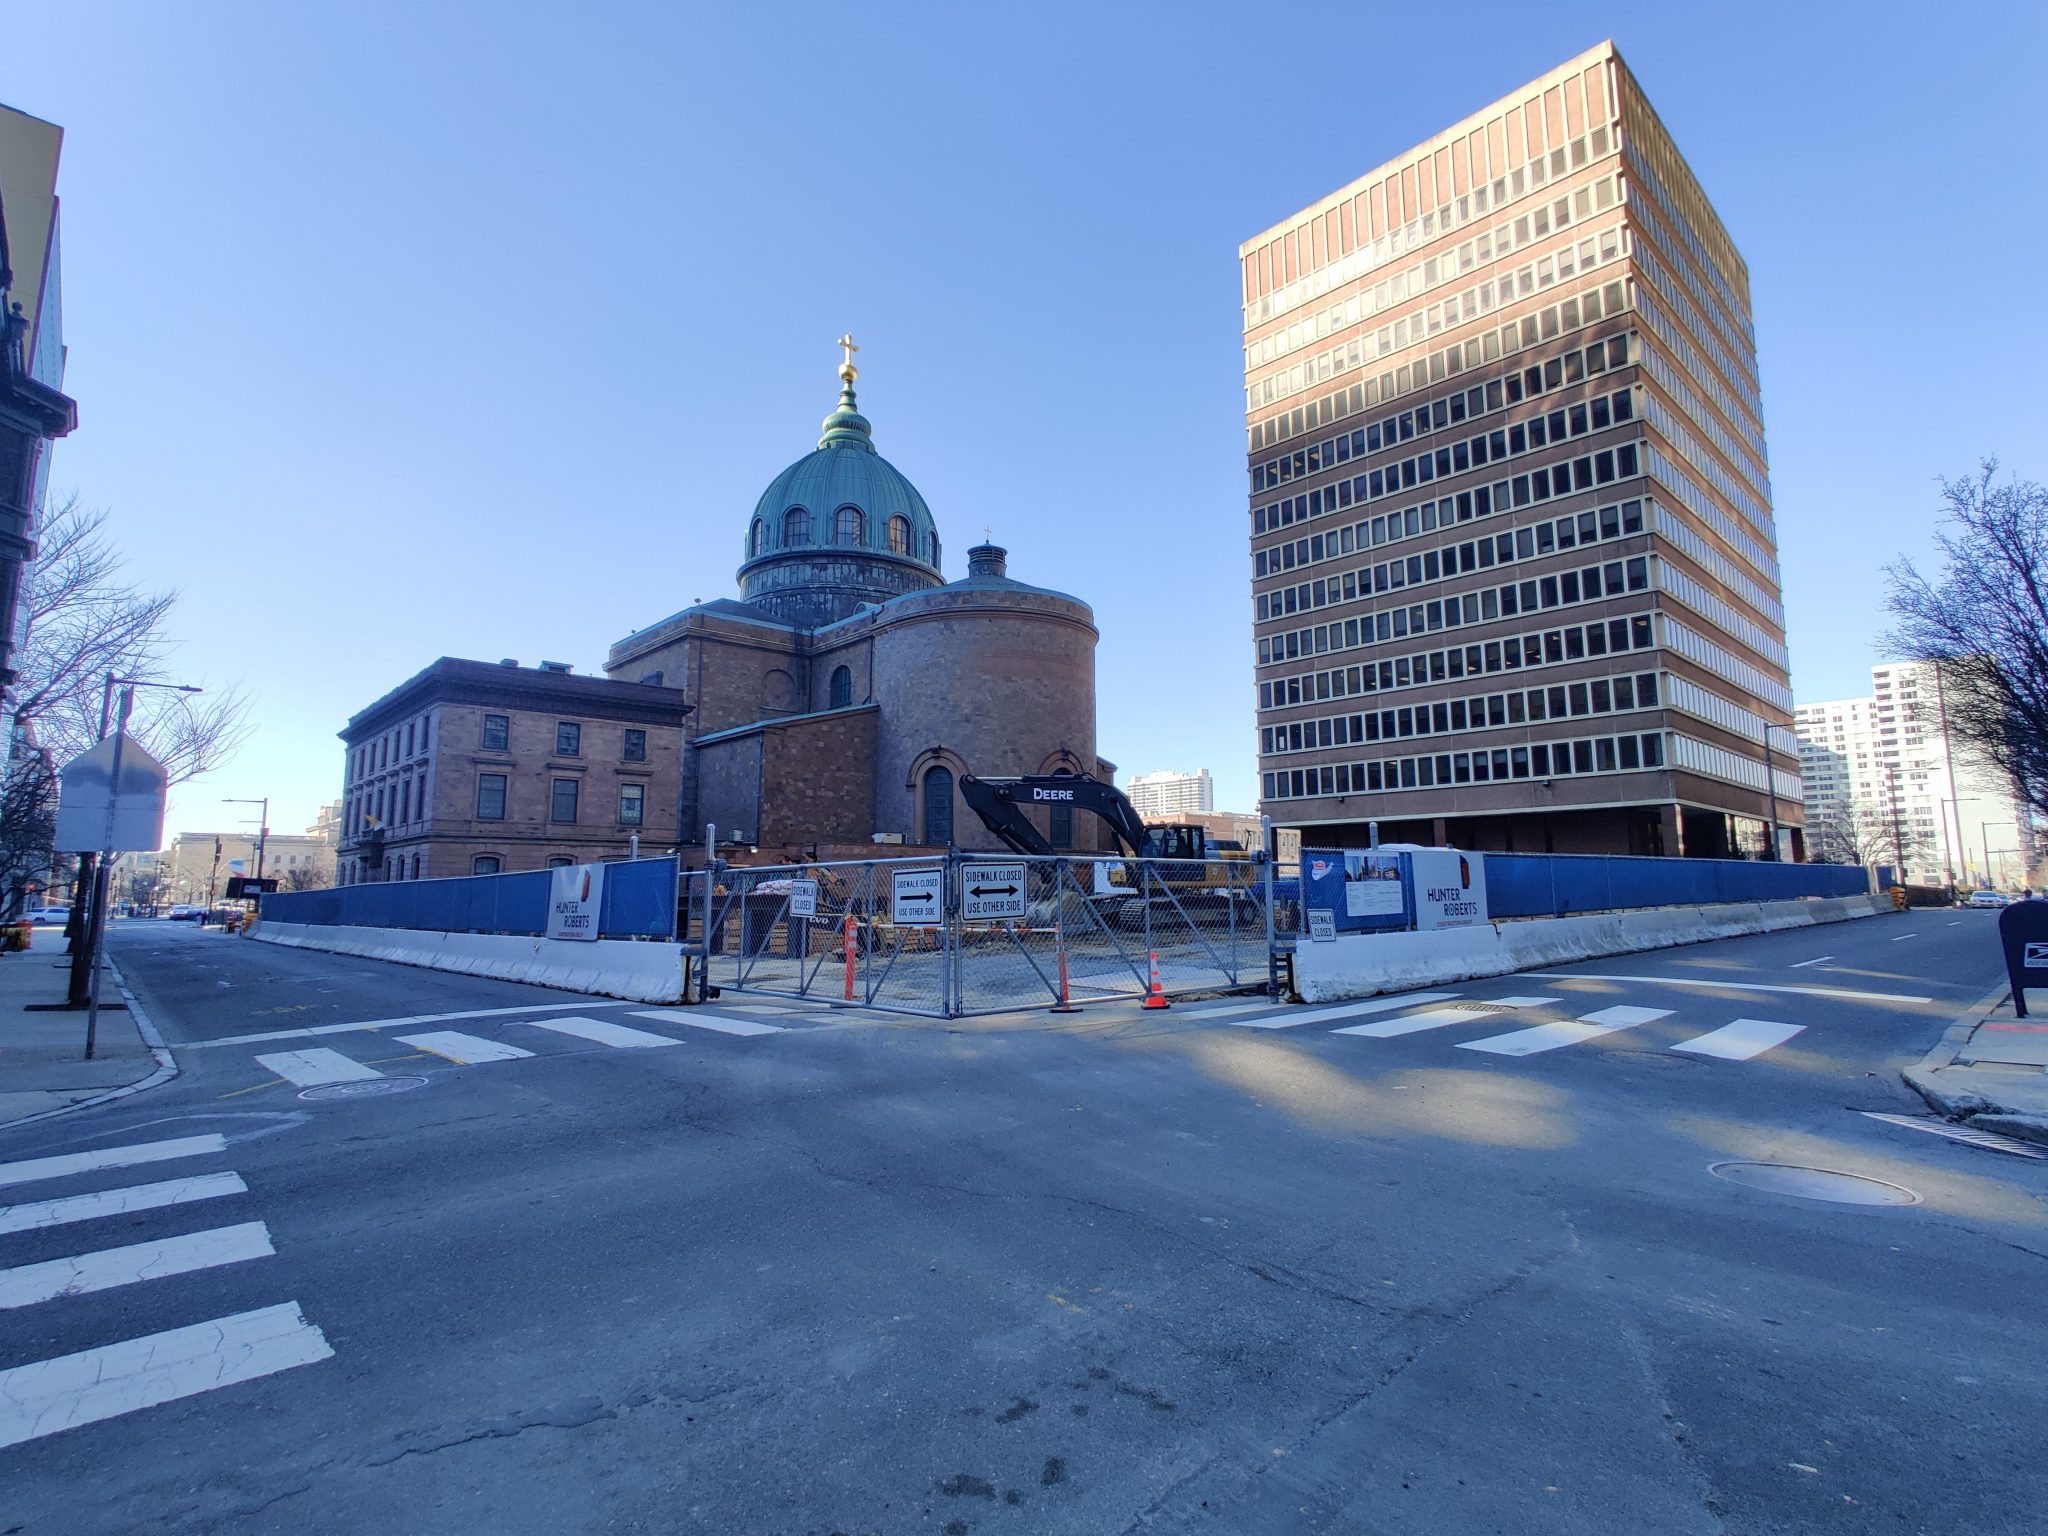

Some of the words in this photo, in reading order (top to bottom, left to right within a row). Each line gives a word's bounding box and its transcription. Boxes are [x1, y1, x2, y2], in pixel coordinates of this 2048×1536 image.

[1033, 787, 1074, 800] DEERE
[966, 870, 998, 882] SIDEWALK
[999, 870, 1022, 881] CLOSED
[896, 880, 919, 889] SIDEWALK
[920, 878, 939, 888] CLOSED
[793, 886, 814, 897] SIDEWALK
[1427, 888, 1461, 902] HUNTER
[556, 901, 579, 914] HUNTER
[794, 900, 811, 911] CLOSED
[898, 908, 907, 916] USE
[908, 907, 924, 916] OTHER
[924, 907, 935, 916] SIDE
[967, 902, 981, 913] USE
[982, 901, 1005, 912] OTHER
[1006, 900, 1021, 911] SIDE
[1443, 902, 1478, 917] ROBERTS
[564, 915, 590, 928] ROBERTS
[1310, 915, 1333, 925] SIDEWALK
[1314, 928, 1333, 938] CLOSED
